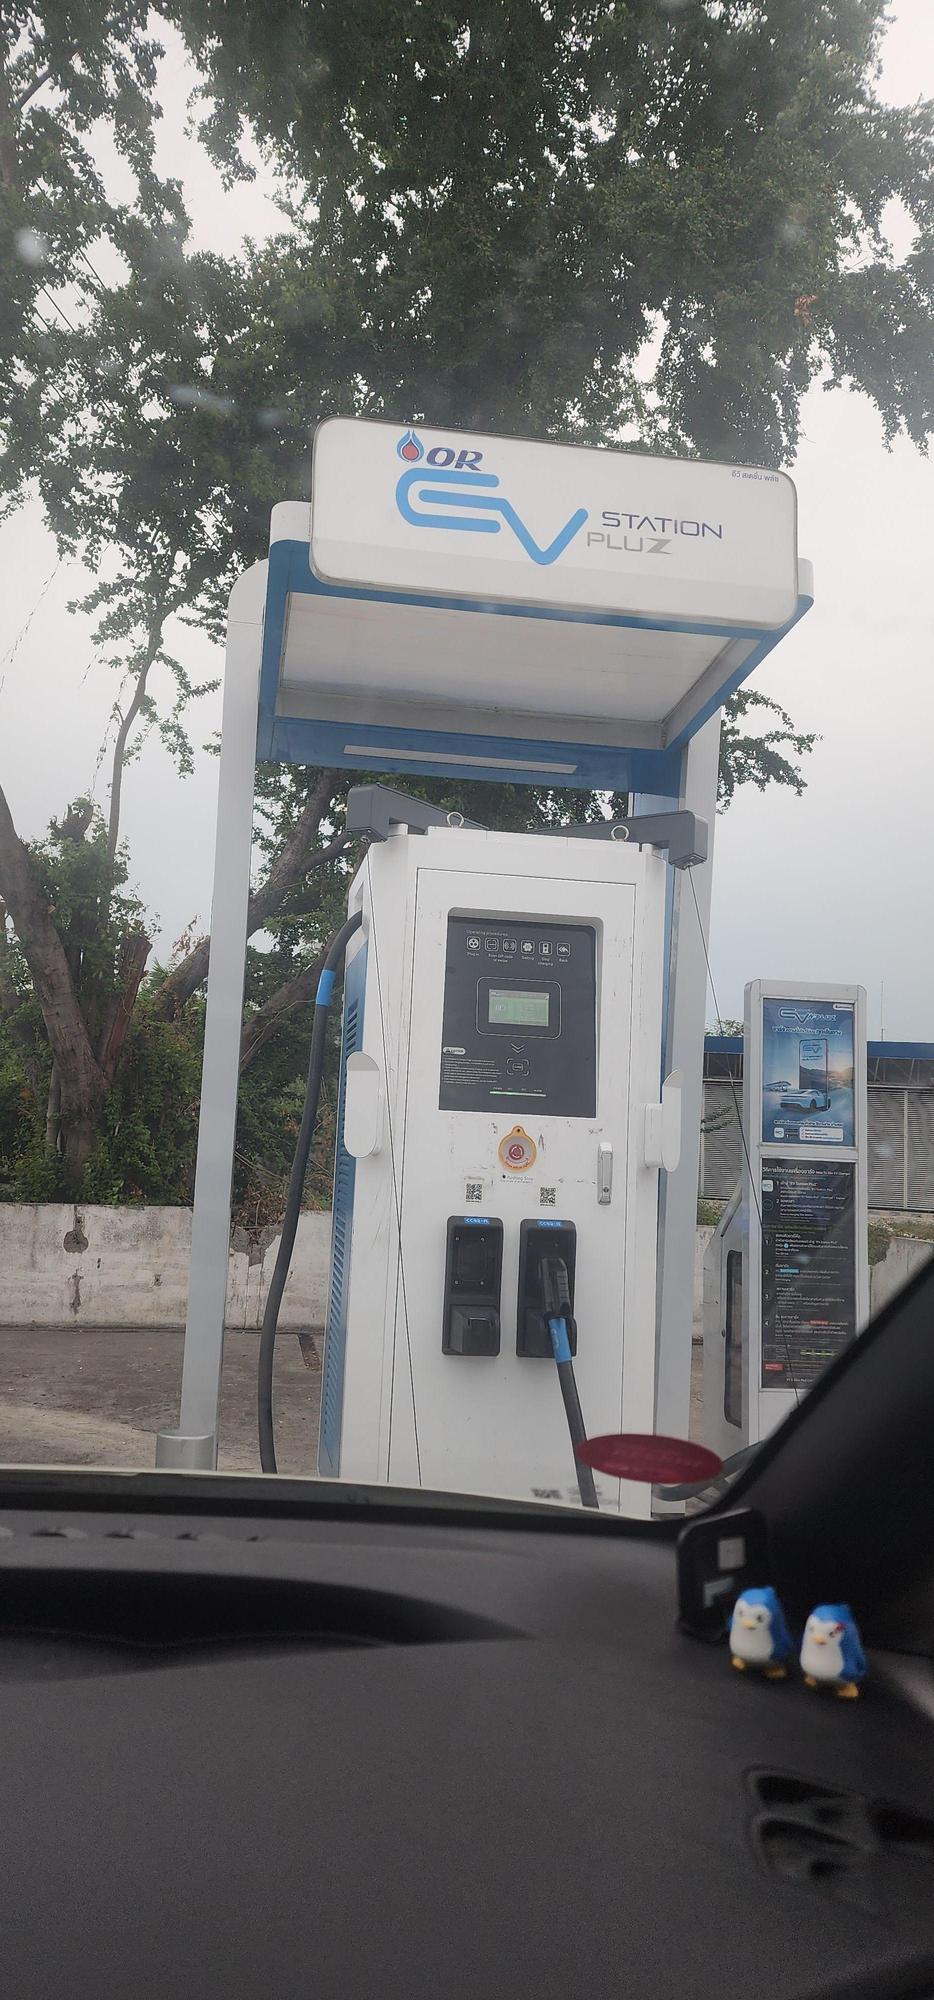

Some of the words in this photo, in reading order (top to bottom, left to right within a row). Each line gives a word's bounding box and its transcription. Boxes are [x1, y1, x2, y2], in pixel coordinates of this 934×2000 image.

[425, 446, 484, 472] OR
[395, 467, 589, 566] EV
[601, 510, 723, 540] STATION
[587, 531, 674, 556] PLUZ
